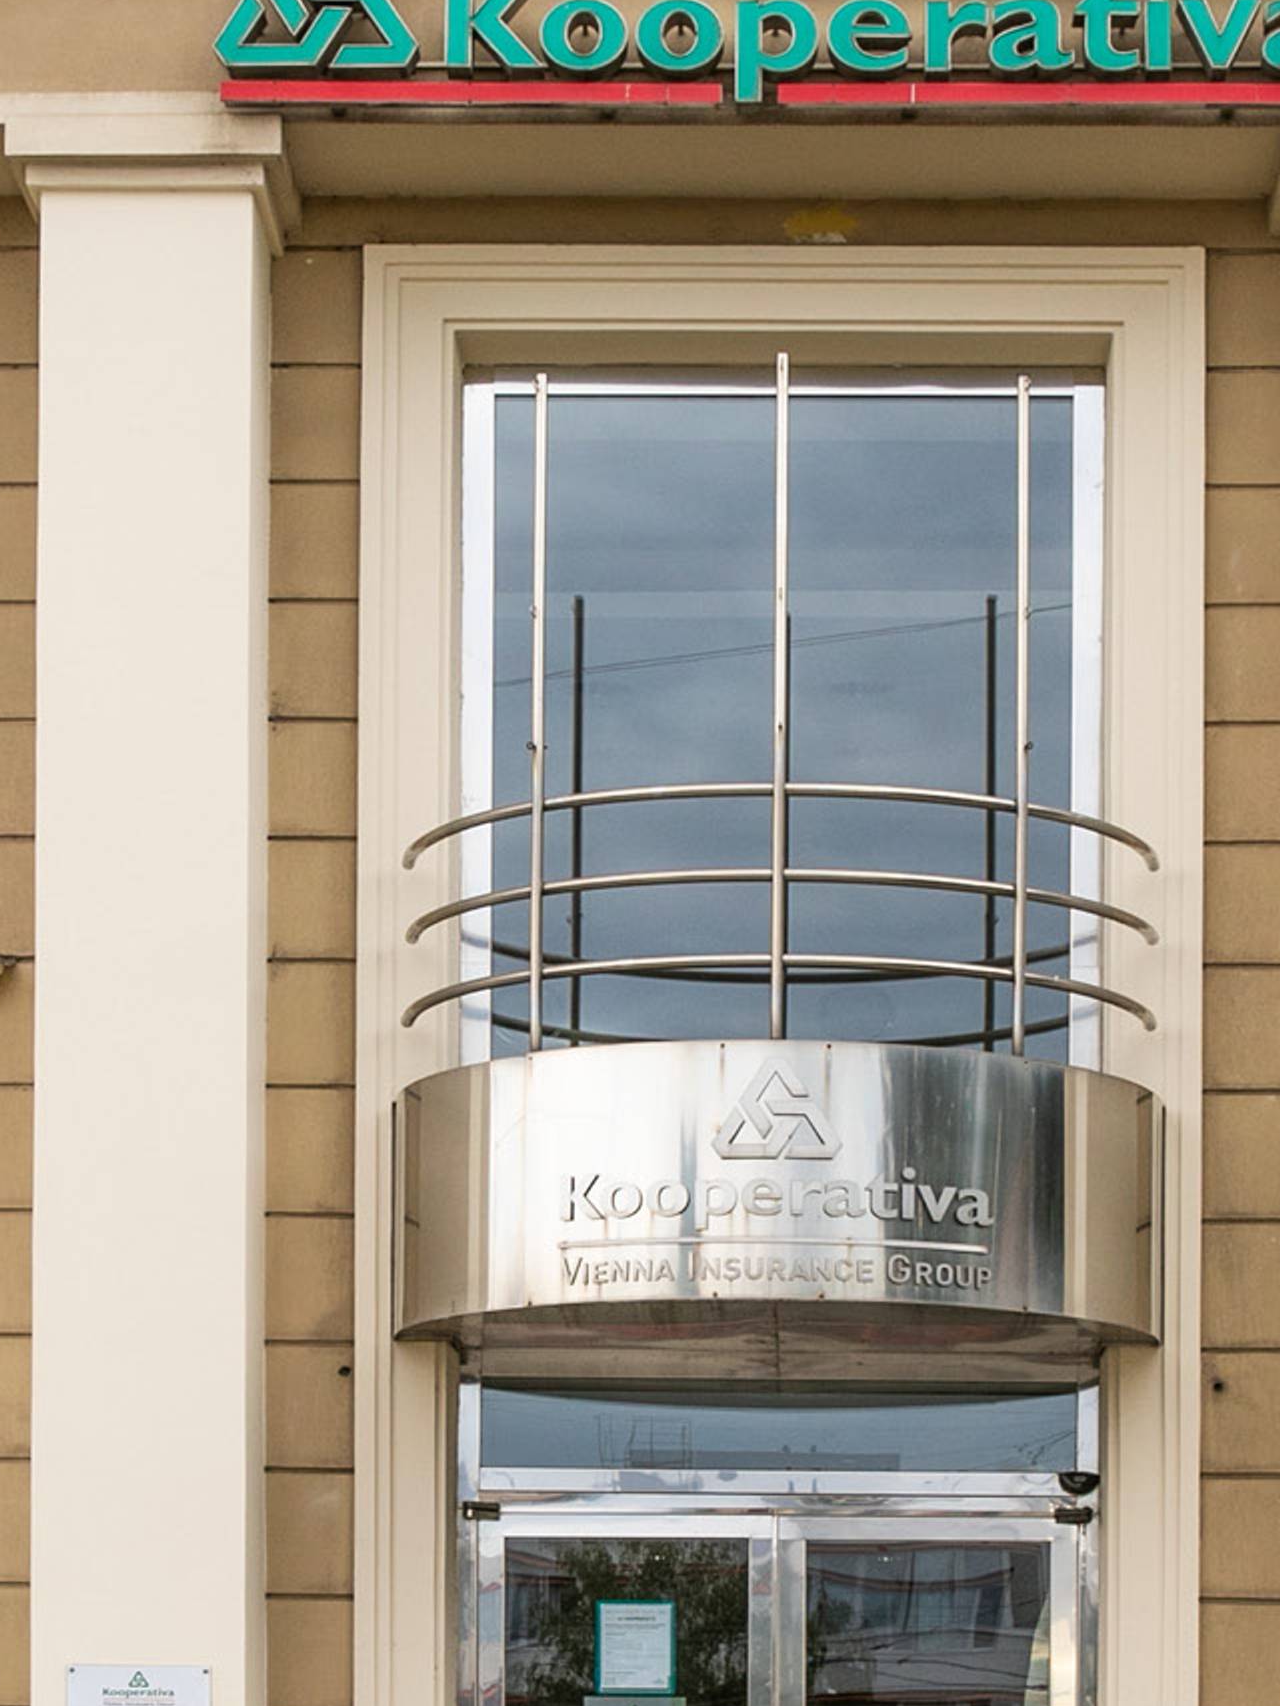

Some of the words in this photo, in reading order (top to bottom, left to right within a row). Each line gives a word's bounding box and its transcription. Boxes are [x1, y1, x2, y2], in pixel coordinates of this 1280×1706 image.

[559, 1166, 995, 1232] Kooperativa
[560, 1254, 676, 1287] VIENNA
[687, 1253, 875, 1285] INSURANCE
[887, 1253, 995, 1292] GROUP
